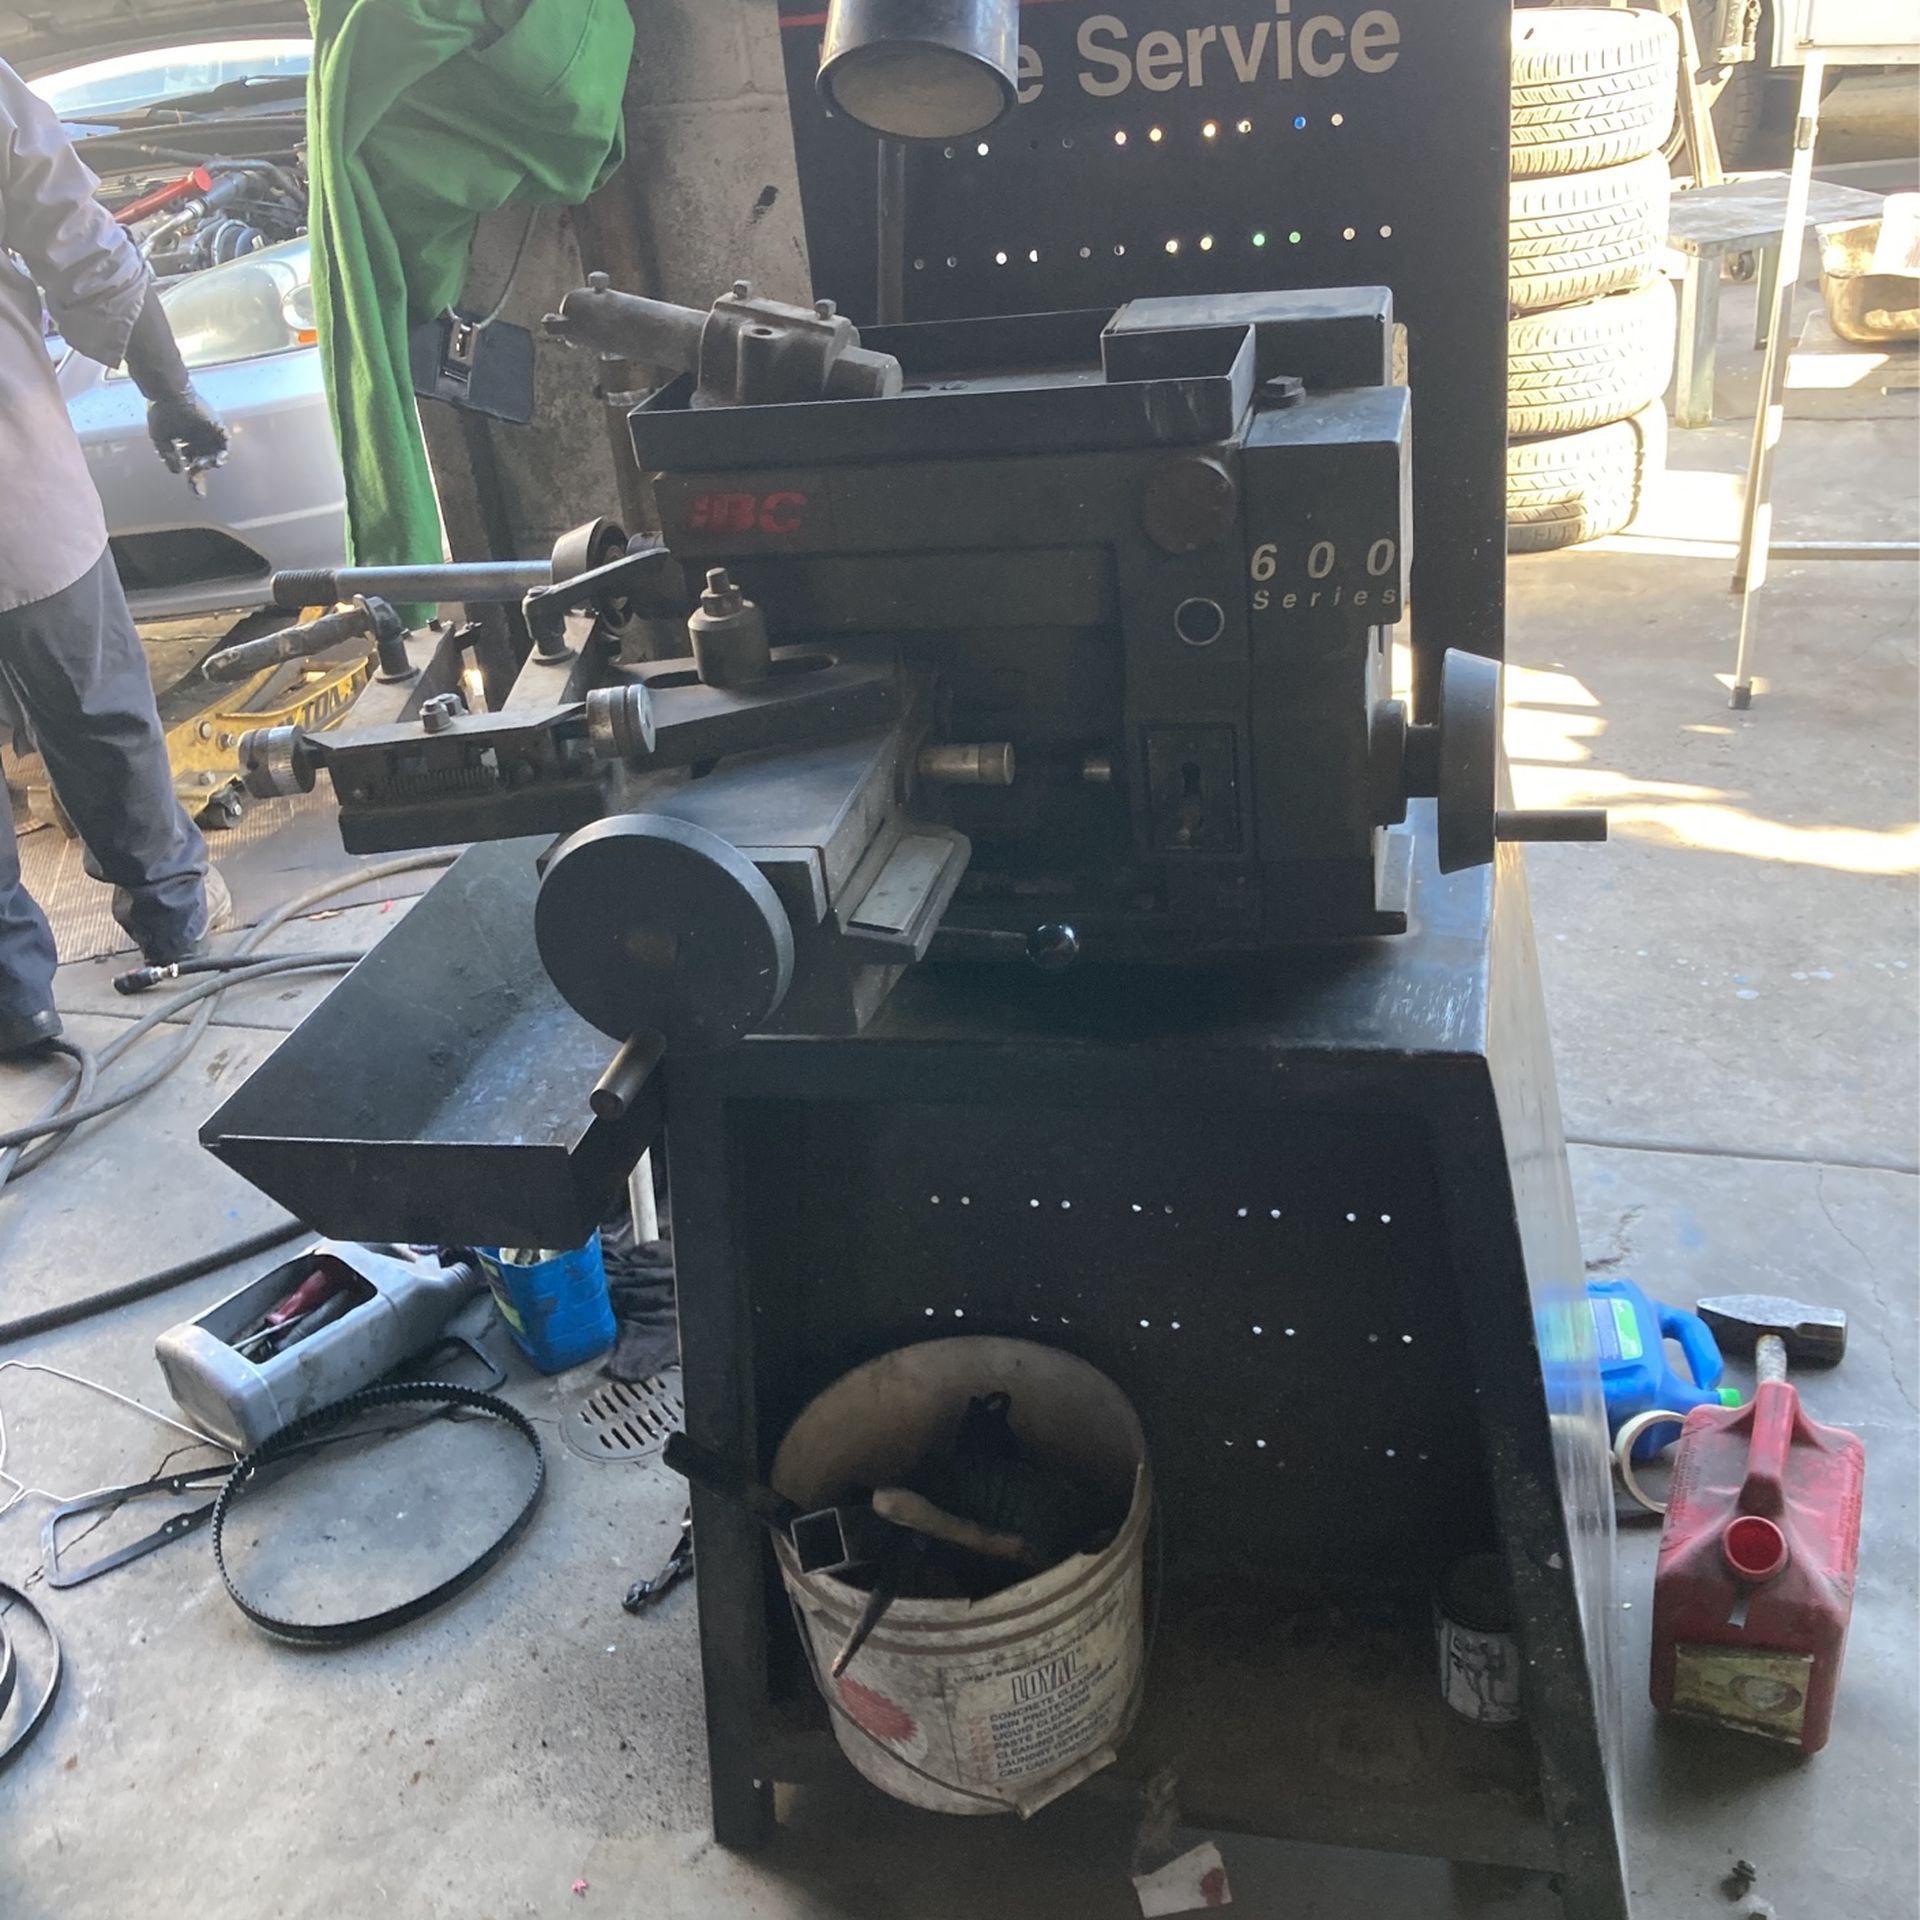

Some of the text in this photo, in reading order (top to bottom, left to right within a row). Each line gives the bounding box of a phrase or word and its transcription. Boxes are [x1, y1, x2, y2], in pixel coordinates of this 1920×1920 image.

[1076, 0, 1400, 97] Service
[1252, 586, 1397, 610] Series
[1011, 1651, 1088, 1705] LOYAL
[989, 1693, 1054, 1722] CONCRETE
